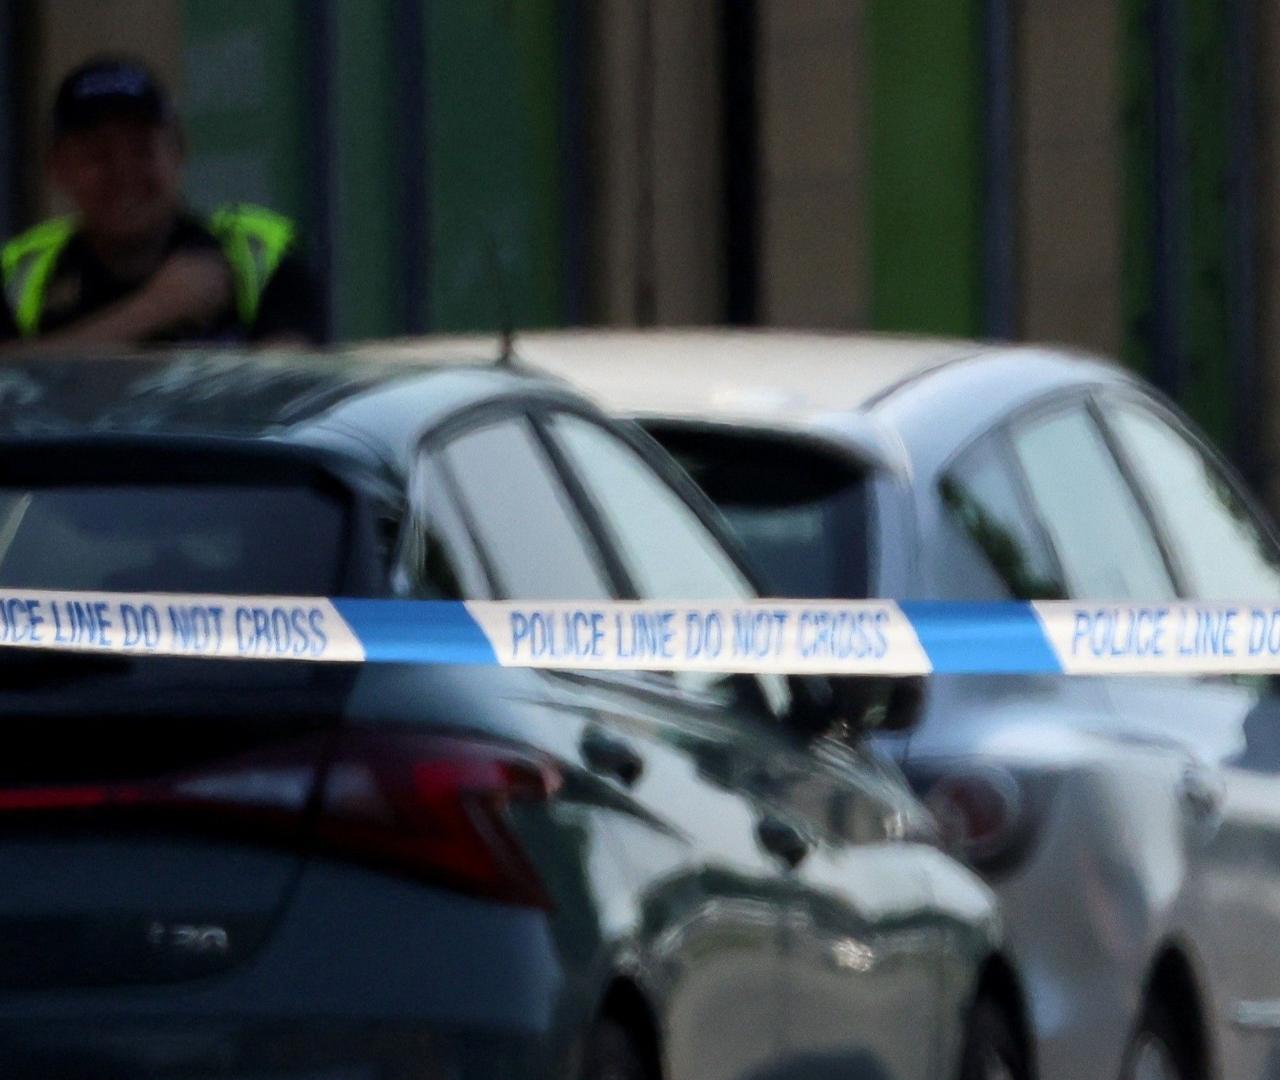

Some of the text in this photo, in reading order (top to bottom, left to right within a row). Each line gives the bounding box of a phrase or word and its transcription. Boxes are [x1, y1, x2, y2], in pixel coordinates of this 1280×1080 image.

[51, 600, 112, 647] LINE
[120, 603, 160, 647] DO
[167, 605, 223, 653] NOT
[235, 606, 328, 657] CROSS
[510, 609, 891, 660] POLICE LINE DO NOT CROSS
[1072, 608, 1168, 656] POLICE
[1176, 608, 1239, 656] LINE
